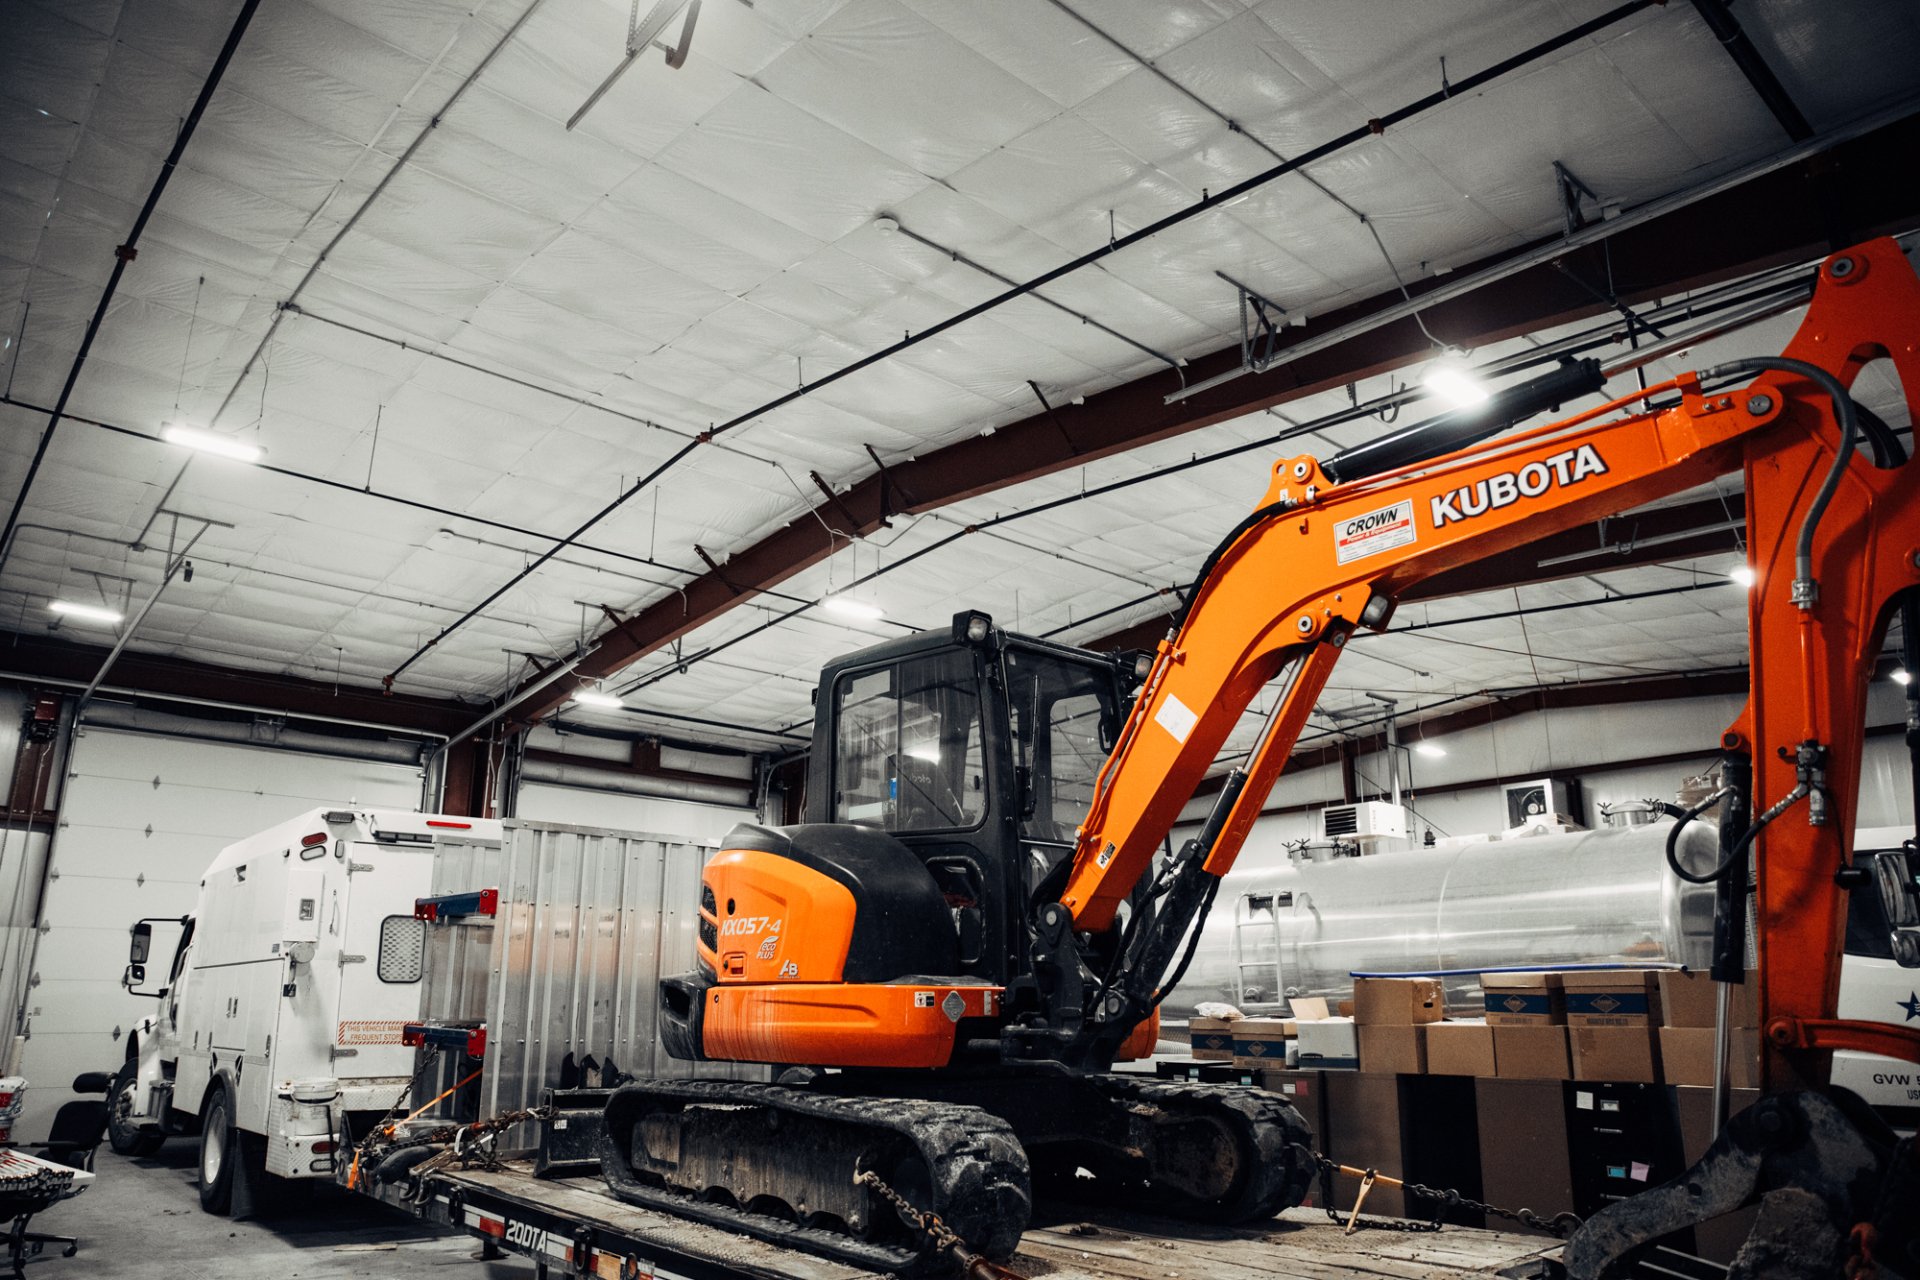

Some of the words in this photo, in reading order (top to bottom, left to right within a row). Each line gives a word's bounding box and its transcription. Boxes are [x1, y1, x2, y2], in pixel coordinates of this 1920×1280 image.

[1430, 444, 1608, 529] KUBOTA
[1346, 508, 1398, 536] CROWN
[721, 916, 782, 936] KX057-4
[756, 951, 774, 960] PLUS
[350, 1033, 382, 1041] FREQUENT
[1873, 1073, 1910, 1085] GVW
[1906, 1089, 1920, 1100] US
